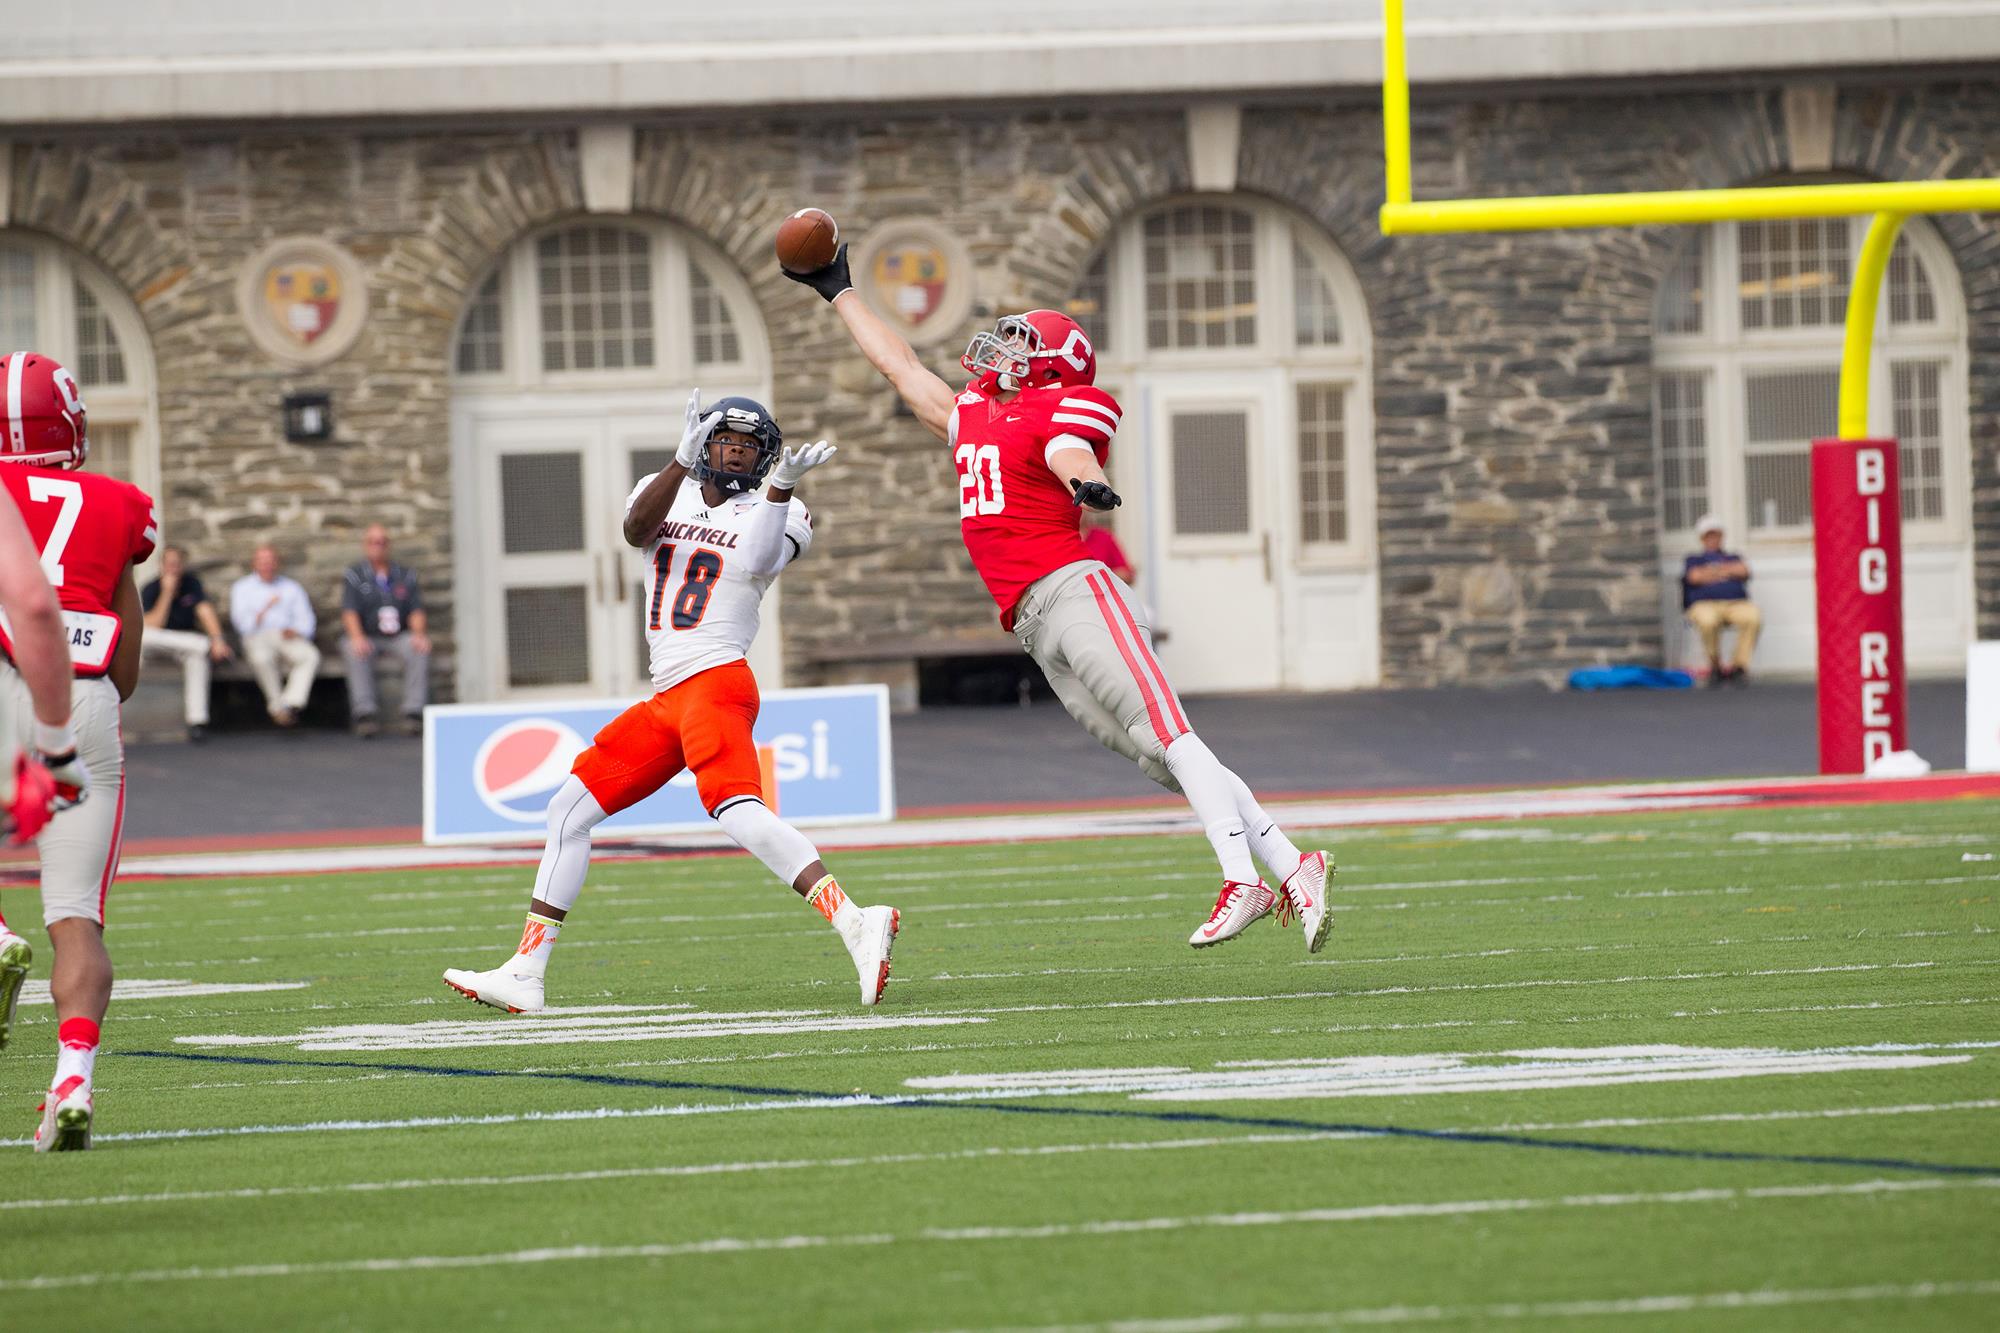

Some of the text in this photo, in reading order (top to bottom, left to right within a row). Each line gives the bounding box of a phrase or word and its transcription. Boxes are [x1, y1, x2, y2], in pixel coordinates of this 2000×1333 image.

[1060, 329, 1092, 371] C
[955, 443, 1006, 519] 20
[1856, 448, 1888, 594] BIG
[27, 475, 83, 587] 7
[657, 521, 739, 549] BUCKNELL
[650, 543, 724, 631] 18
